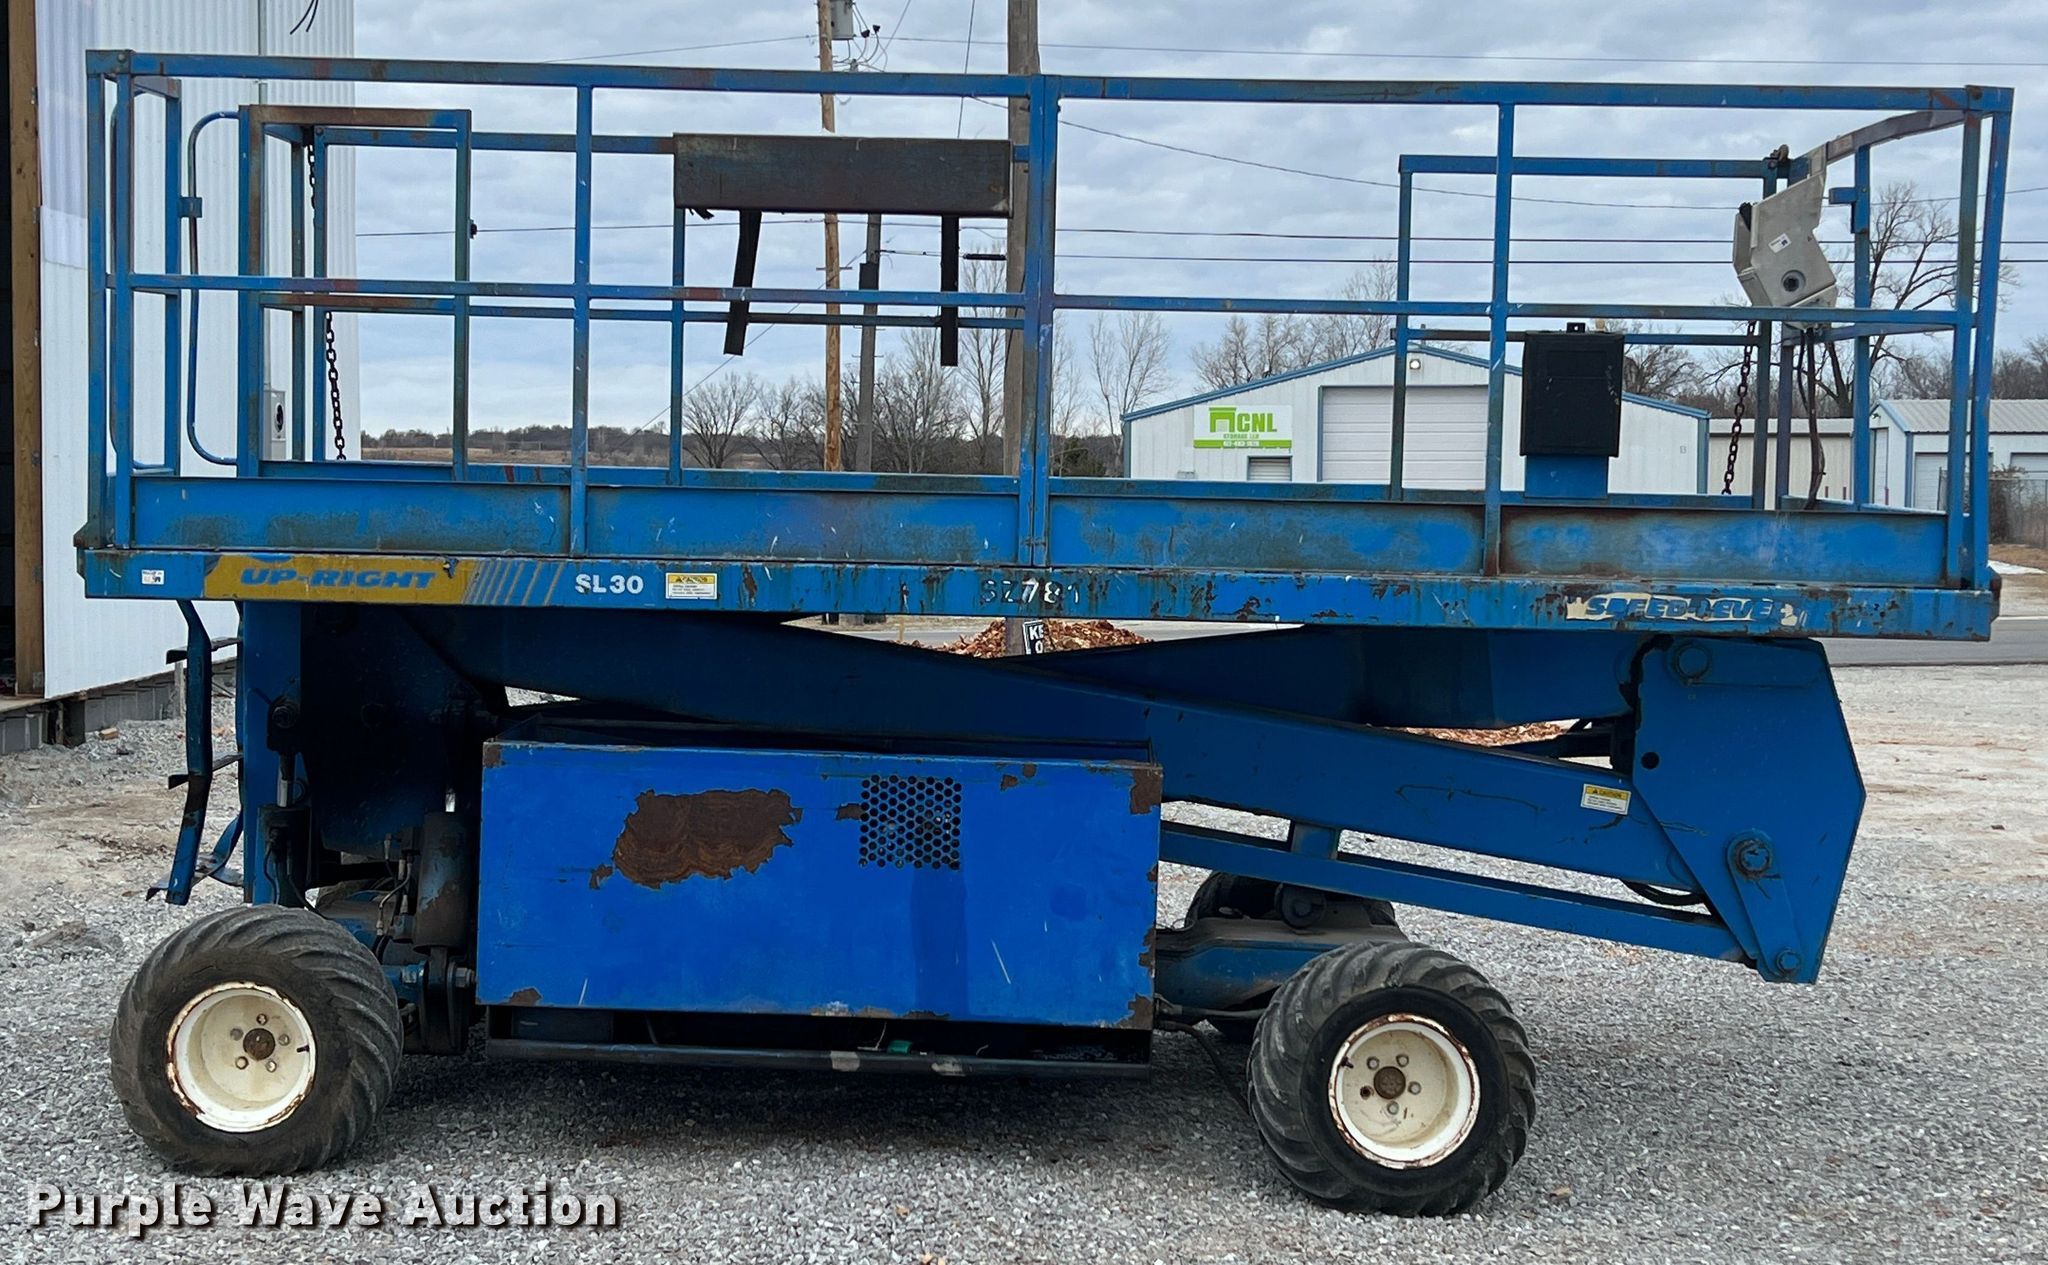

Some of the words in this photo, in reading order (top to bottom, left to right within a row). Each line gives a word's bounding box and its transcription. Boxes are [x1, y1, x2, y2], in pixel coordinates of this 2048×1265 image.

[1236, 412, 1278, 433] CNL
[240, 567, 437, 590] UP-RIGHT
[574, 573, 645, 595] SL30
